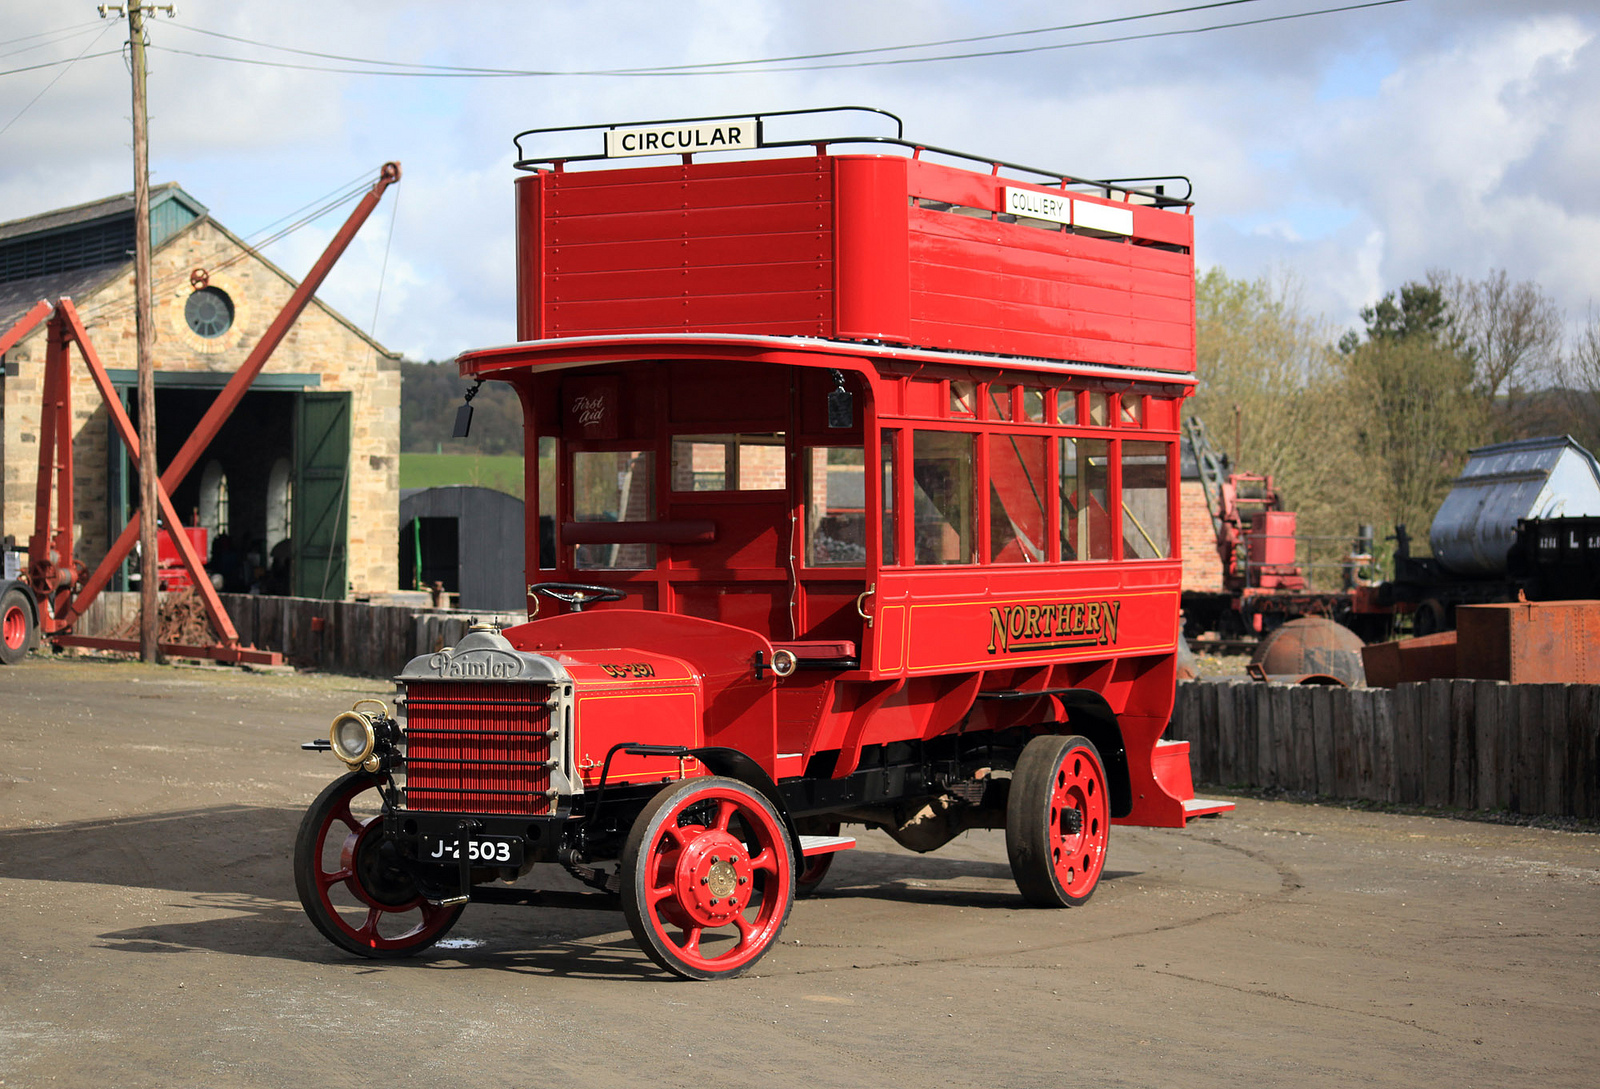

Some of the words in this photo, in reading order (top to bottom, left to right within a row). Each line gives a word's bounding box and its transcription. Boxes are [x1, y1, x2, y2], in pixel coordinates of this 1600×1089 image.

[621, 126, 742, 151] CIRCULAR
[1011, 192, 1064, 217] COLLIERY
[572, 396, 604, 413] First
[987, 600, 1121, 655] NORTHERN
[429, 651, 526, 678] Daimler
